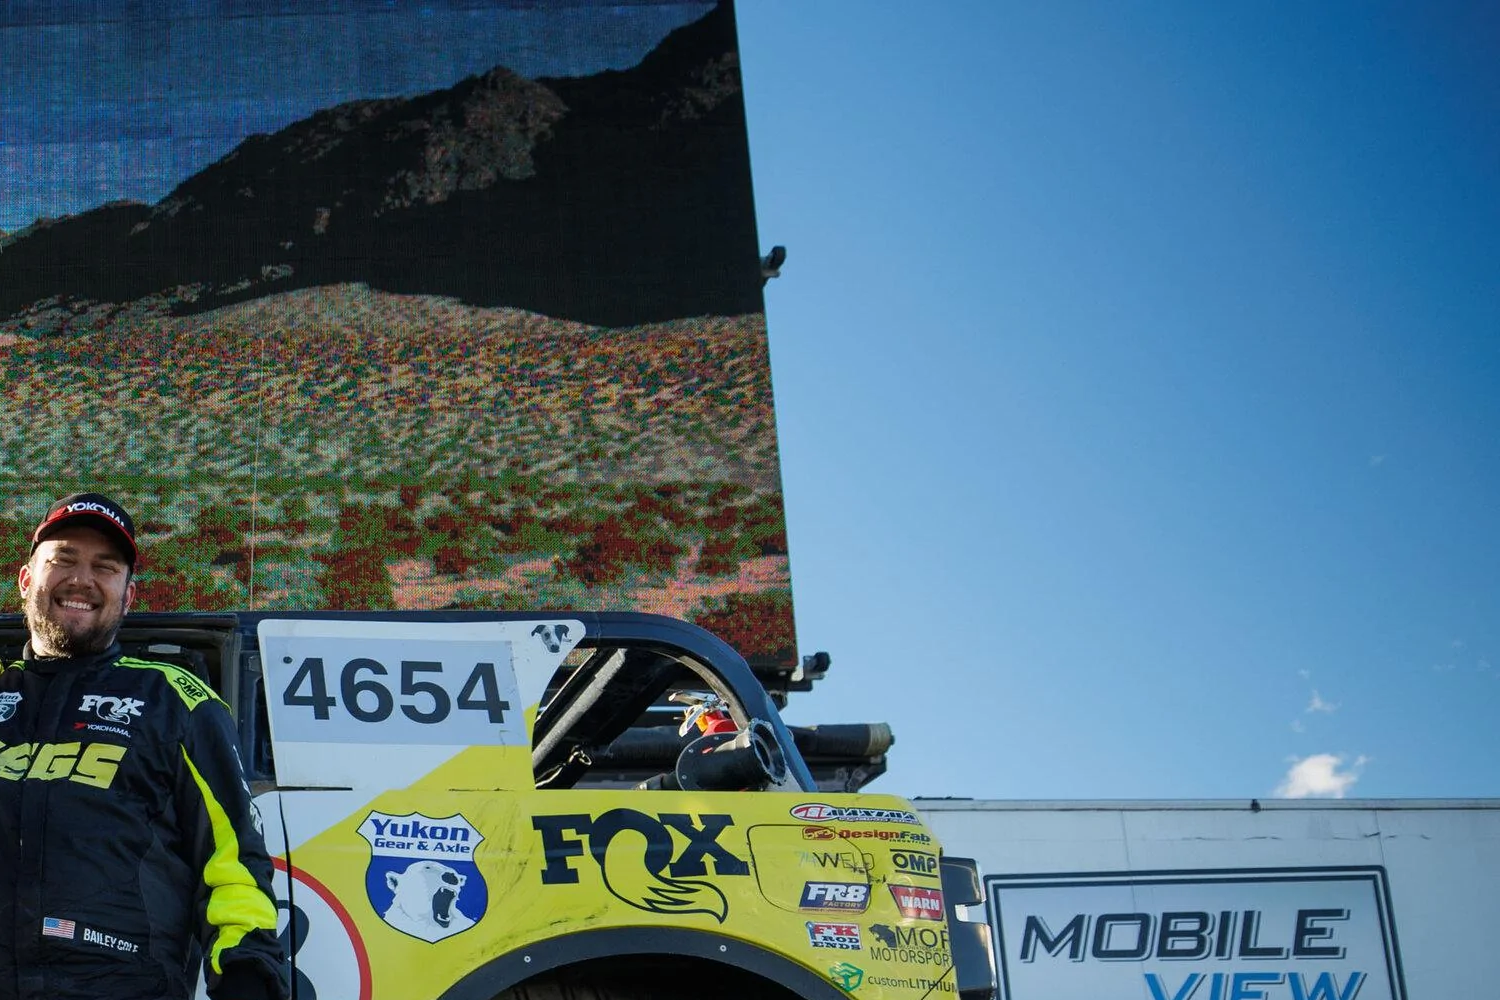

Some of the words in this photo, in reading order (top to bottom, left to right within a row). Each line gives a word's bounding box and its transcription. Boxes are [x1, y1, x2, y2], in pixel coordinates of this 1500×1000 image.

[175, 675, 204, 699] OMP
[282, 656, 510, 725] 4654
[78, 694, 145, 725] FOX
[370, 818, 470, 842] Yukon
[374, 837, 414, 849] Gear
[416, 840, 430, 851] &
[433, 841, 471, 853] Axle
[531, 807, 750, 924] FOX
[892, 851, 938, 873] OMP
[822, 901, 863, 909] FACTORY
[900, 894, 941, 911] WARN
[83, 927, 118, 949] BAILEY
[811, 941, 862, 950] ENDS
[821, 934, 860, 944] ROD
[1019, 908, 1351, 964] MOBILE
